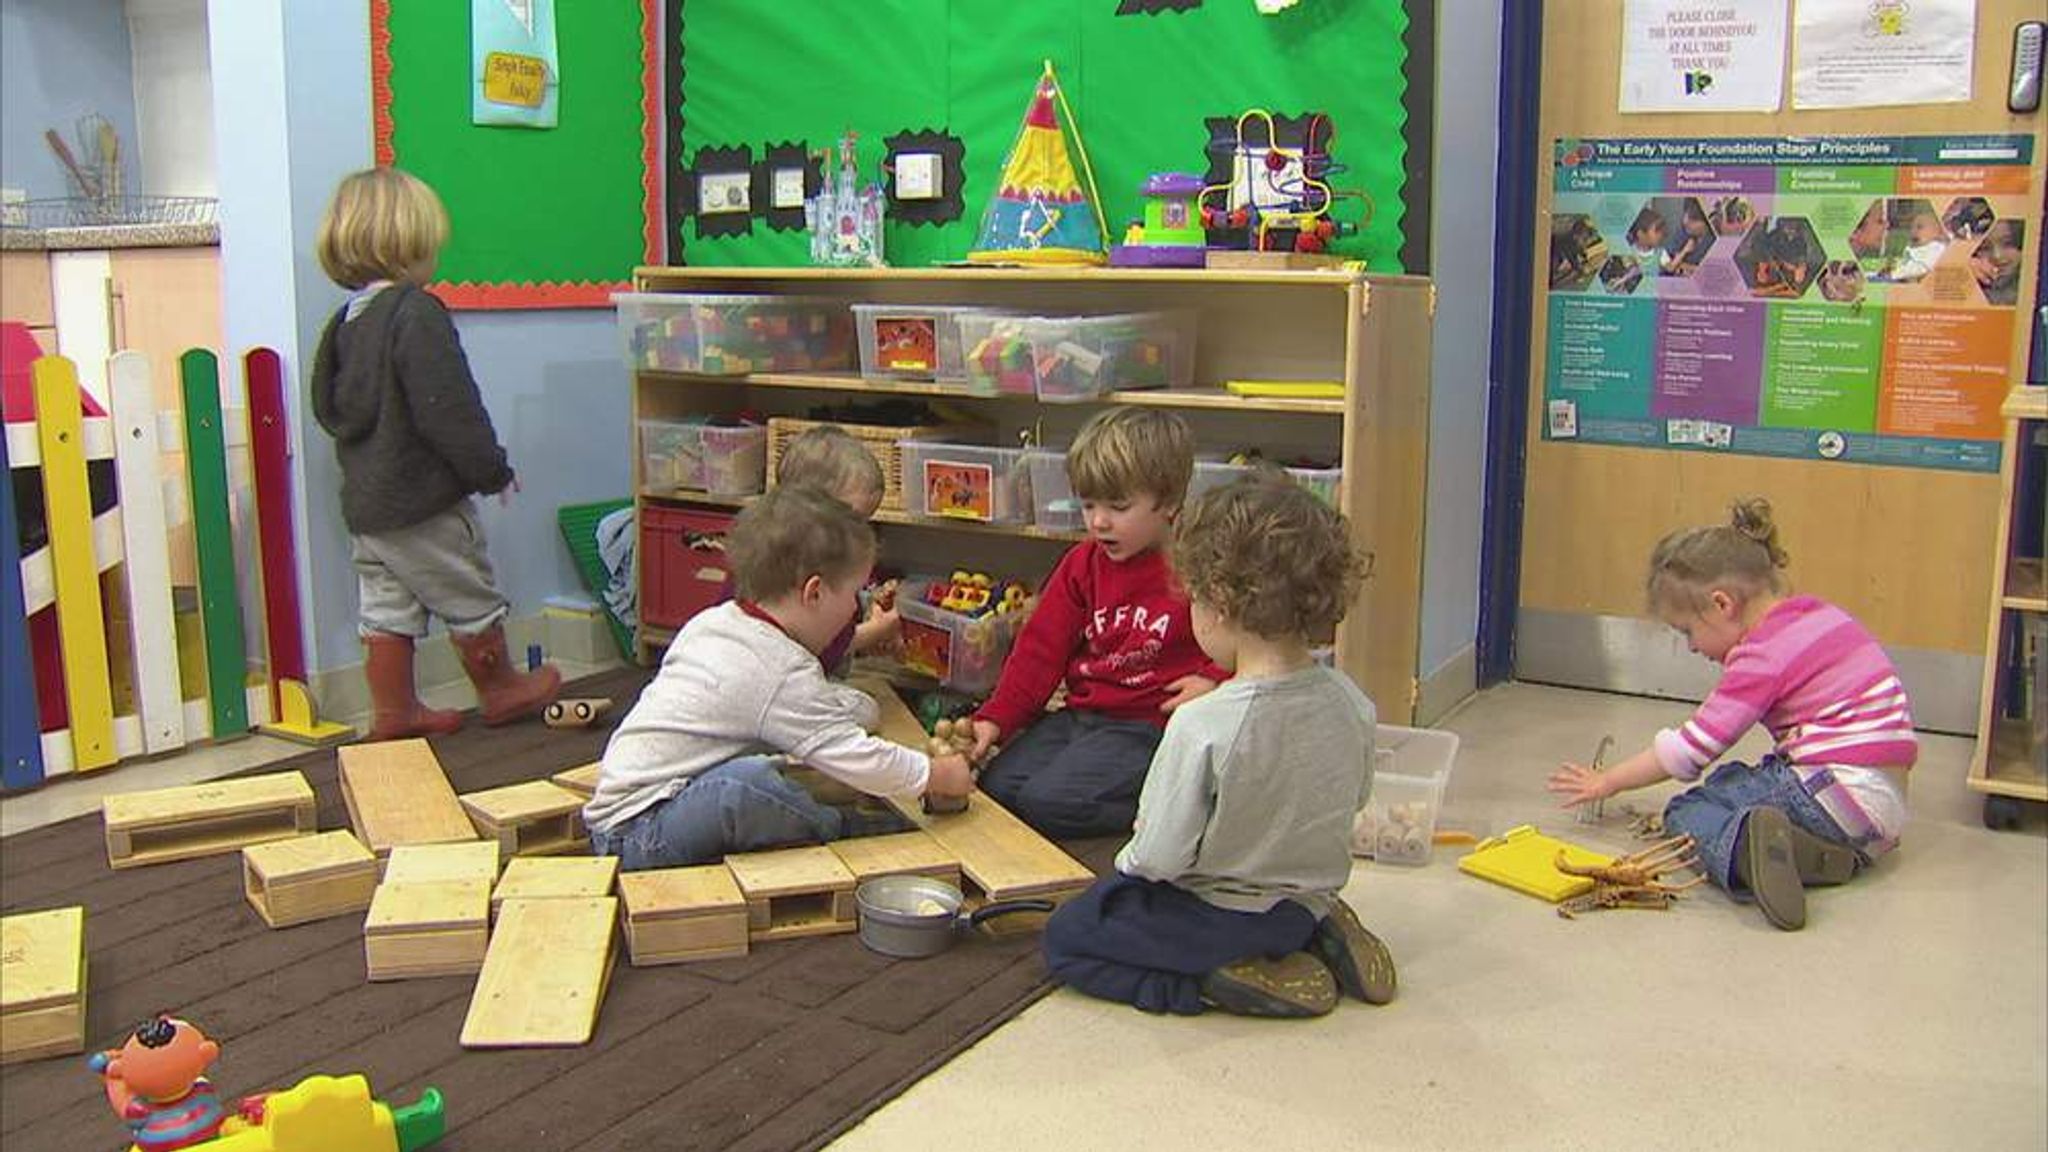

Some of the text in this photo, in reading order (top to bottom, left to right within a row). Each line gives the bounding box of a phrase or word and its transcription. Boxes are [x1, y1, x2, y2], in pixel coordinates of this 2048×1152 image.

[1667, 10, 1736, 23] PLEASE CLOSE
[1648, 26, 1666, 38] THE
[1668, 26, 1696, 38] DOOR
[1668, 41, 1732, 54] AT ALL TIMES
[1671, 57, 1729, 69] THANK YOU
[1598, 141, 1890, 158] The Early Years Foundation Stage Principles
